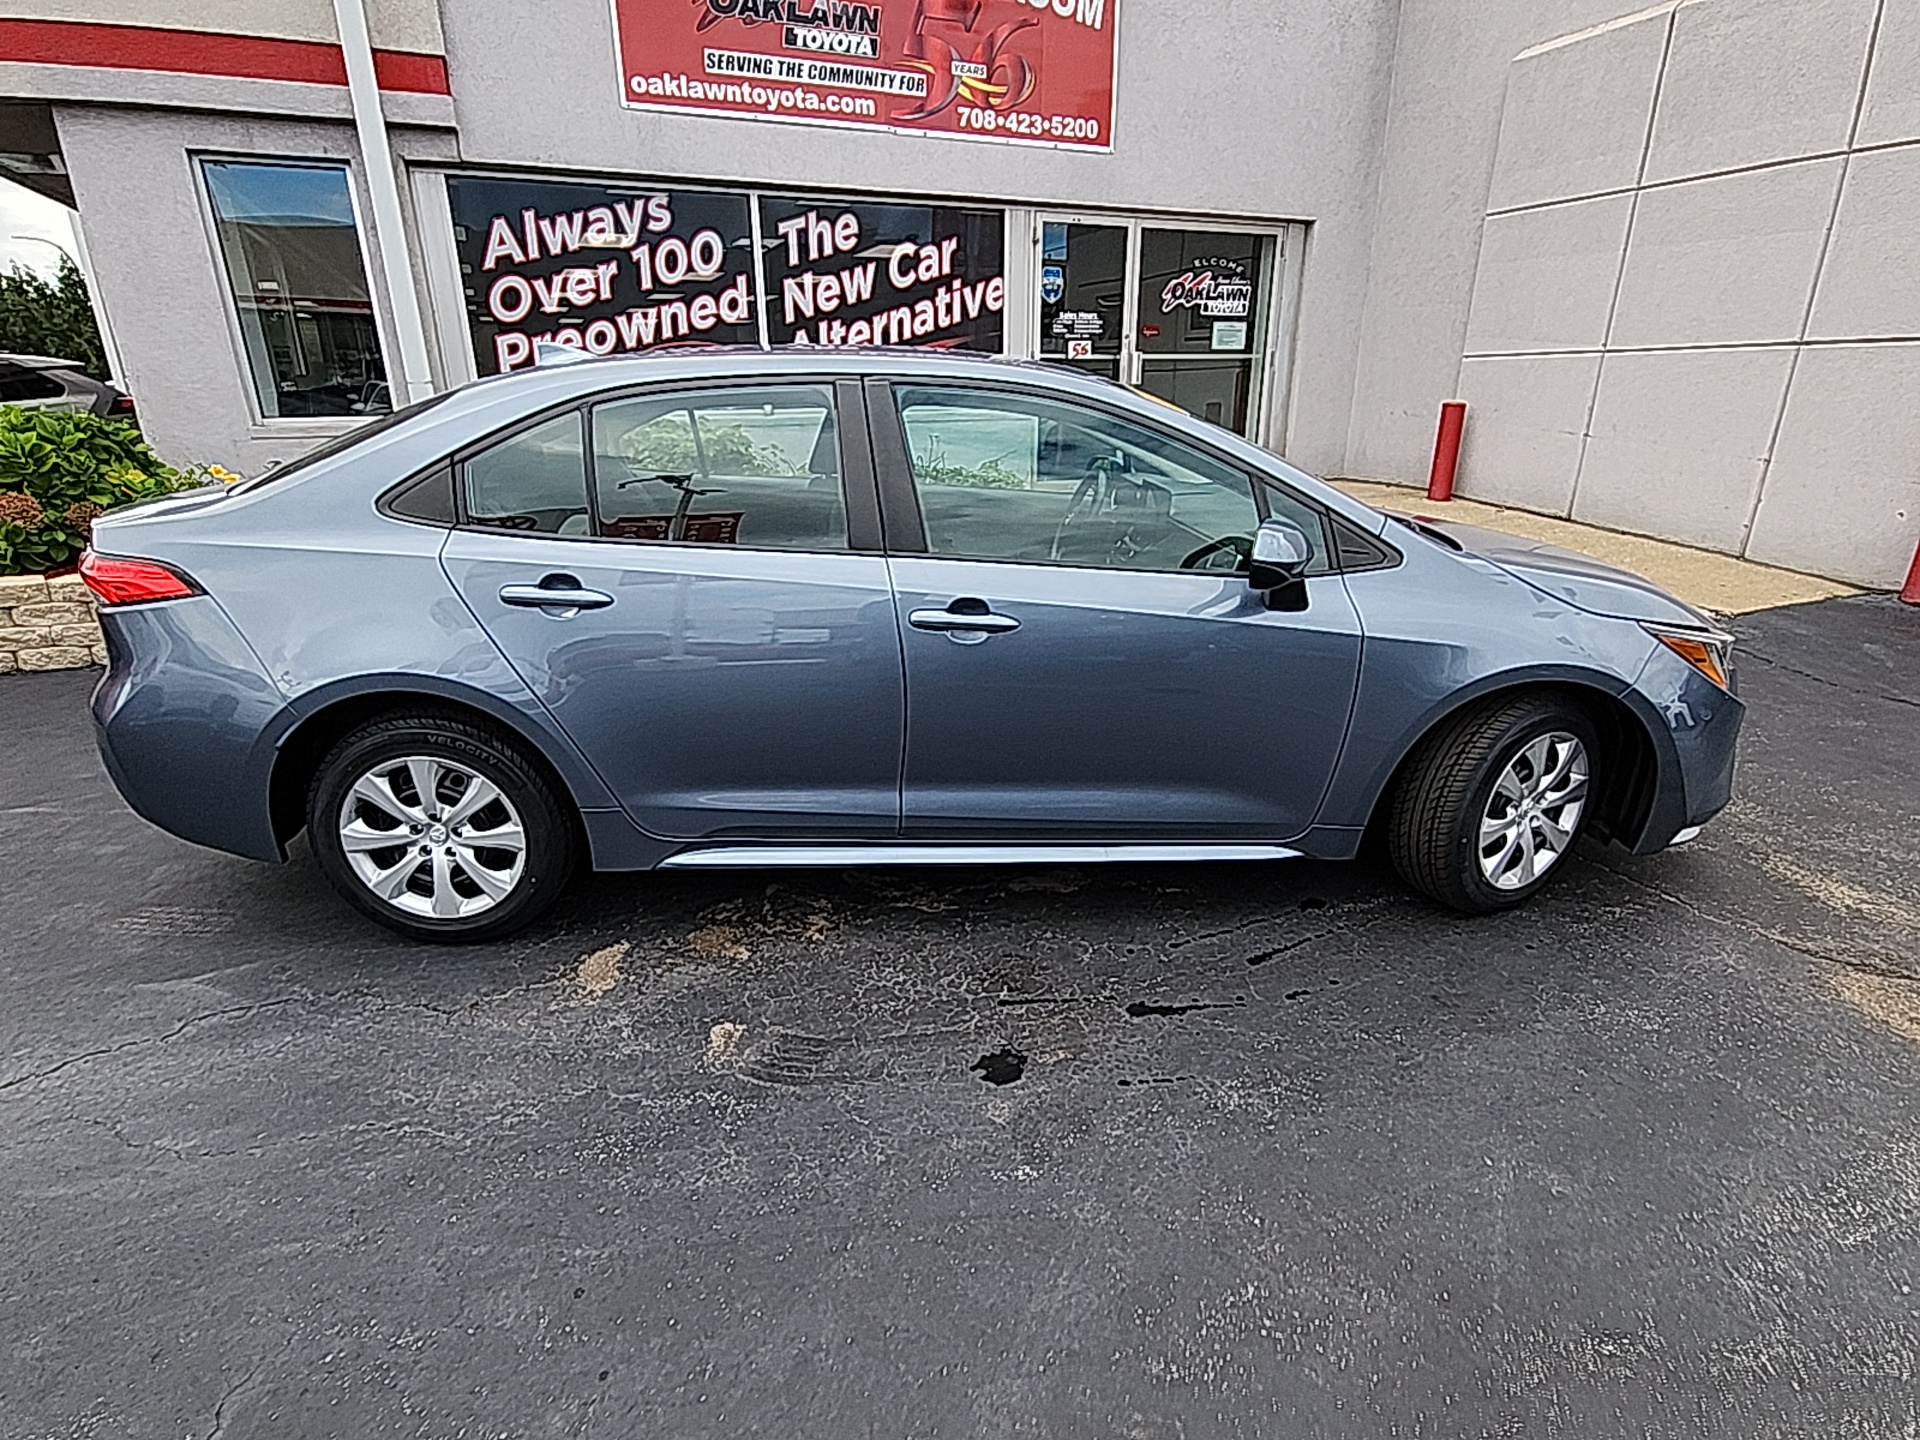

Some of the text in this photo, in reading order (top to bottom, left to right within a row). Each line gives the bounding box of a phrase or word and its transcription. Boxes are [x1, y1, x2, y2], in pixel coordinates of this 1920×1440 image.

[793, 28, 874, 56] TOYOTA
[706, 53, 926, 93] SERVING THE COMMUNITY FOR
[953, 64, 986, 76] YEARS
[630, 73, 876, 116] oaklawntoyota.com
[481, 193, 673, 271] Always
[777, 210, 859, 267] The
[488, 228, 724, 323] Over 100
[783, 237, 958, 324] New Car
[494, 273, 750, 374] Preowned
[1207, 301, 1244, 313] TOYOTA
[427, 734, 498, 765] VELOCITY
